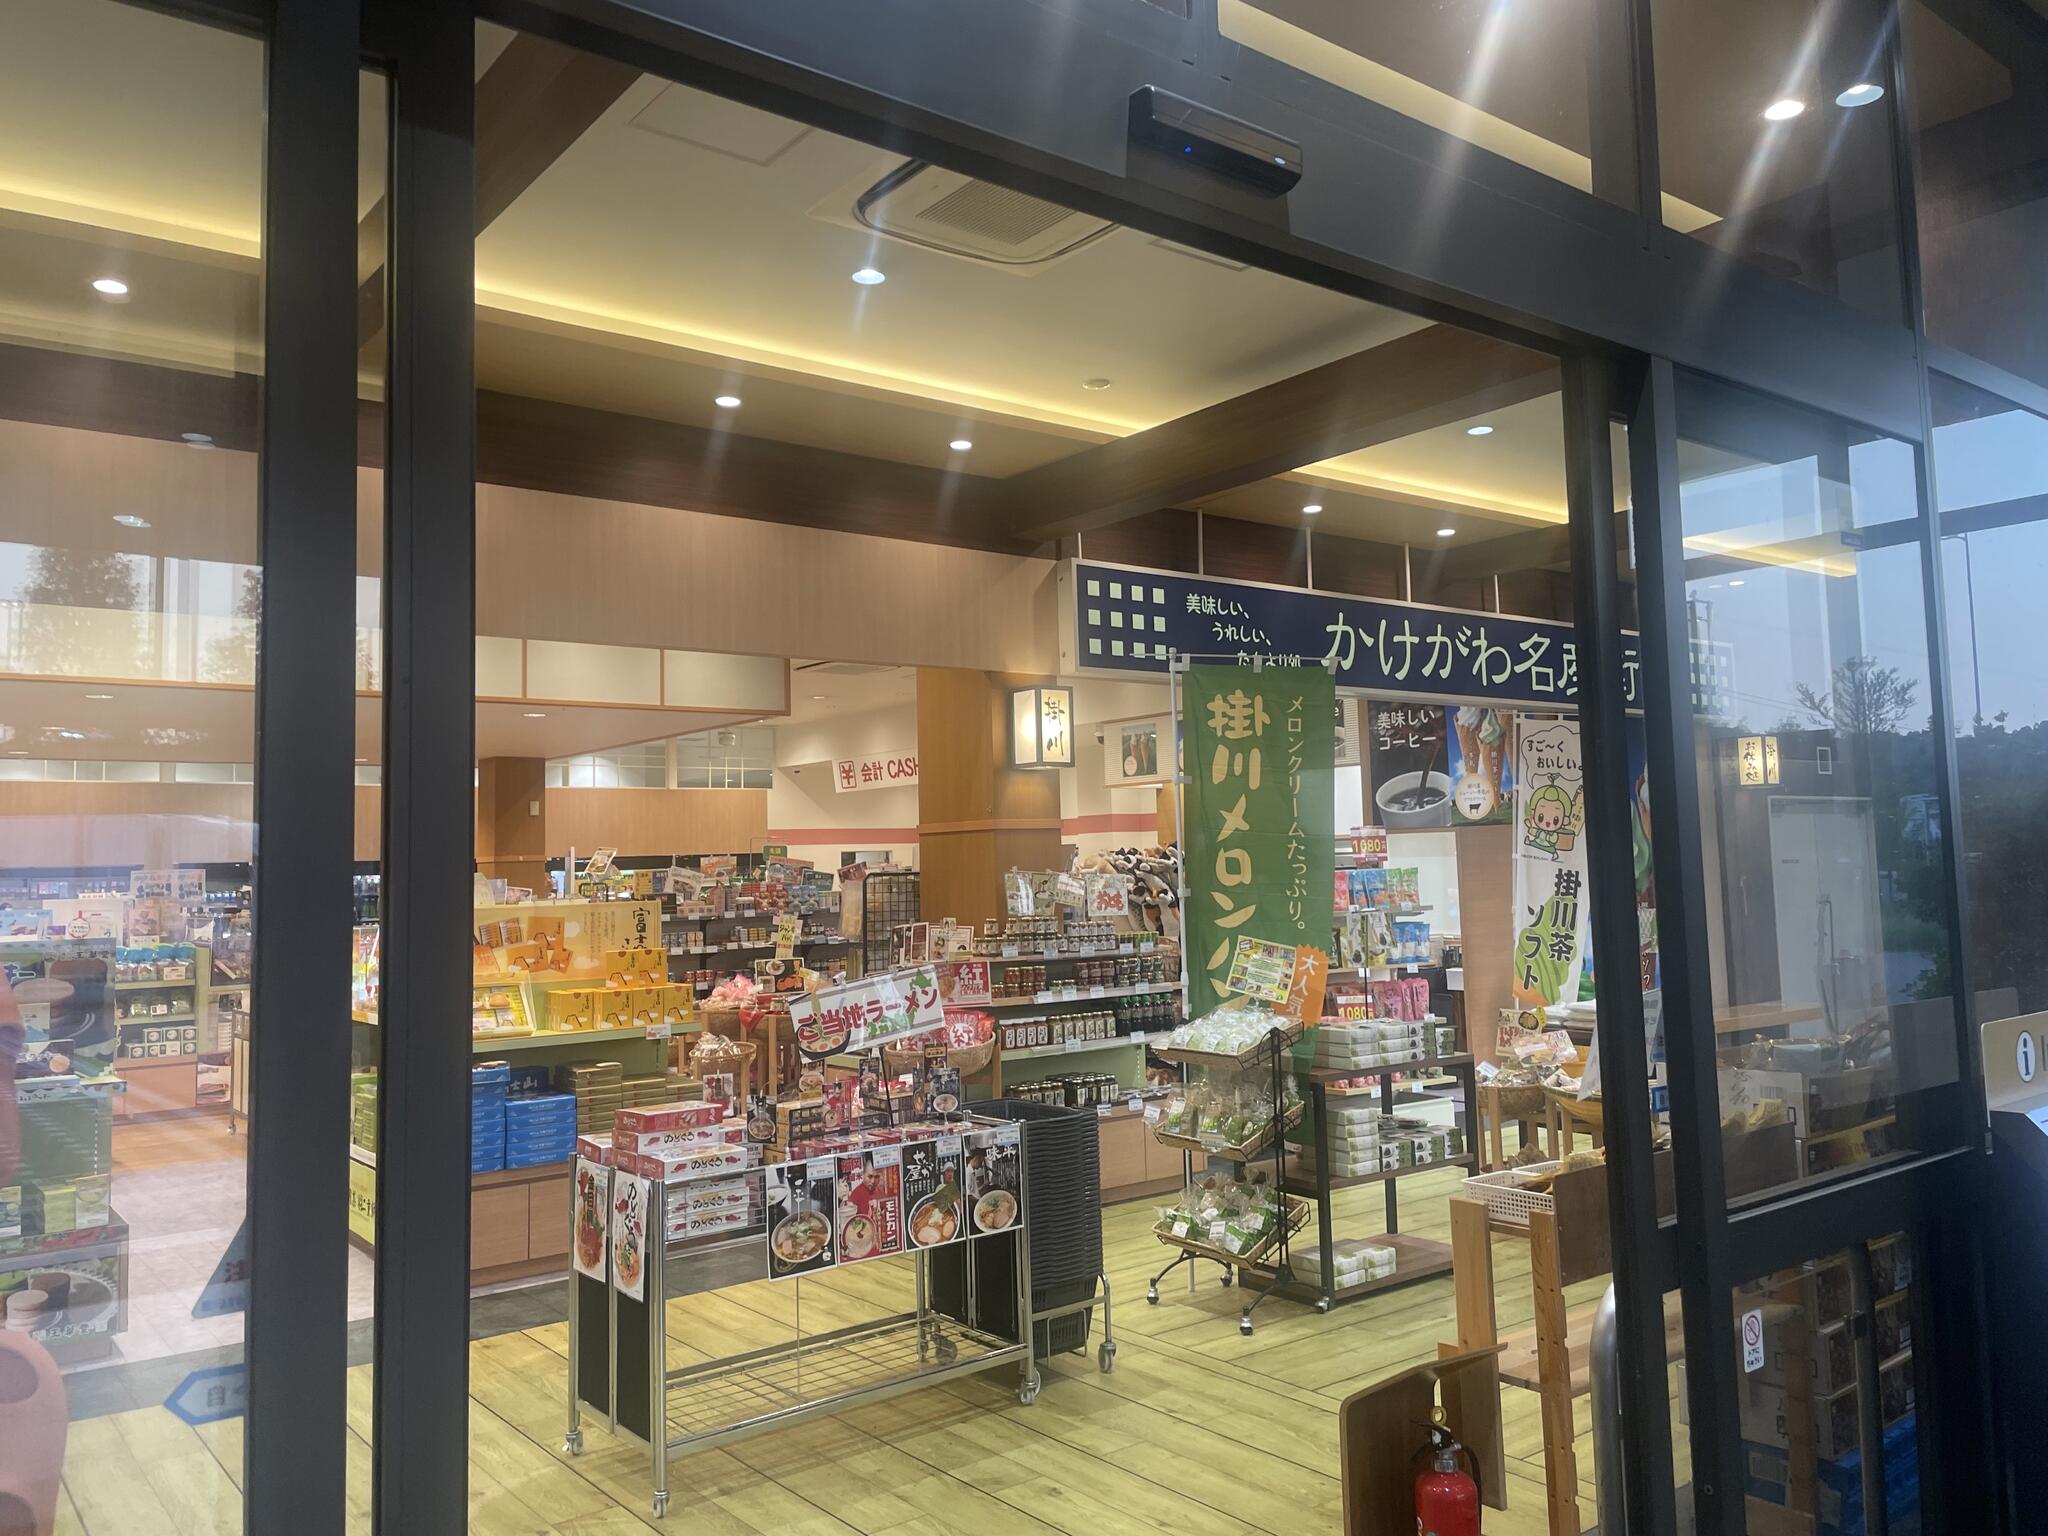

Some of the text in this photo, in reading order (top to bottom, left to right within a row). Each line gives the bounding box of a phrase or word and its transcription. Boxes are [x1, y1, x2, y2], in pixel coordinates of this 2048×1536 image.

[1186, 593, 1250, 619] 美味しい、
[1212, 621, 1272, 646] うれしい、
[1377, 709, 1435, 730] 美味しい
[1379, 733, 1437, 751] コーヒー
[861, 761, 883, 783] 会計
[1286, 696, 1307, 930] メロンクリームたっぷり。
[1549, 868, 1582, 962] 掛川茶
[1524, 905, 1546, 990] ソフト
[797, 988, 938, 1043] ご当地ラーメン
